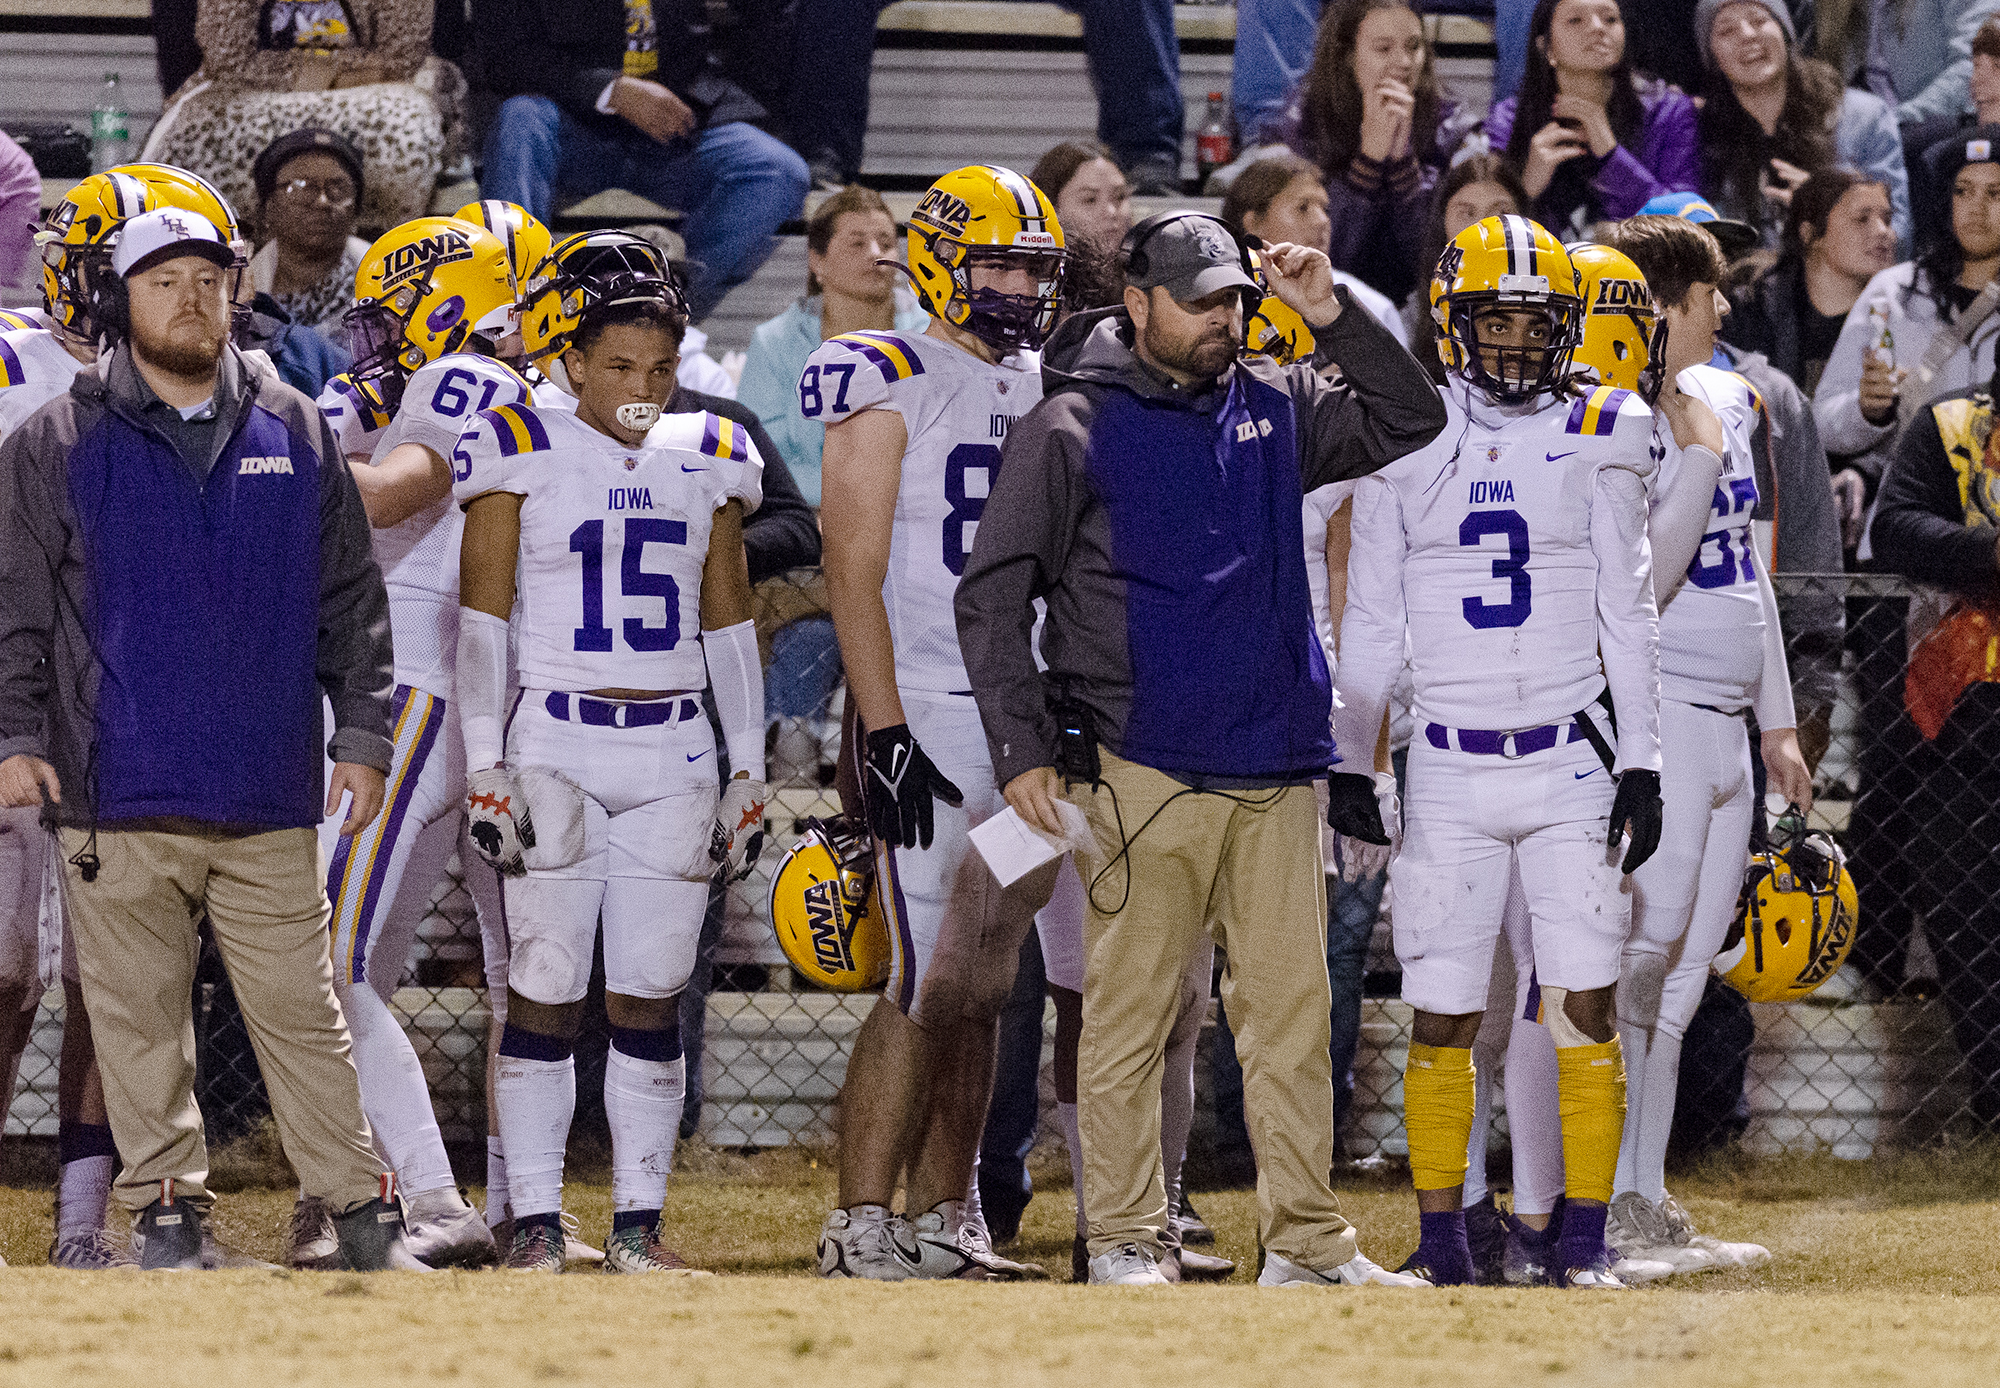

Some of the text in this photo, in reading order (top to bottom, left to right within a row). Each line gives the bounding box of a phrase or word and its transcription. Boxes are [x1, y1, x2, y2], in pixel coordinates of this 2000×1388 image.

[382, 232, 471, 281] IOWA
[1020, 235, 1052, 244] Riddell
[1595, 279, 1652, 307] IOW
[800, 363, 857, 418] 87
[988, 413, 1021, 438] IOW
[1236, 418, 1274, 443] IOA
[237, 456, 295, 475] IOWA
[451, 431, 480, 484] 5
[608, 487, 654, 511] IOWA
[942, 443, 1004, 577] 8
[1469, 480, 1515, 504] IOWA
[569, 517, 688, 653] 15
[1459, 509, 1532, 630] 3
[804, 880, 848, 972] IOWA
